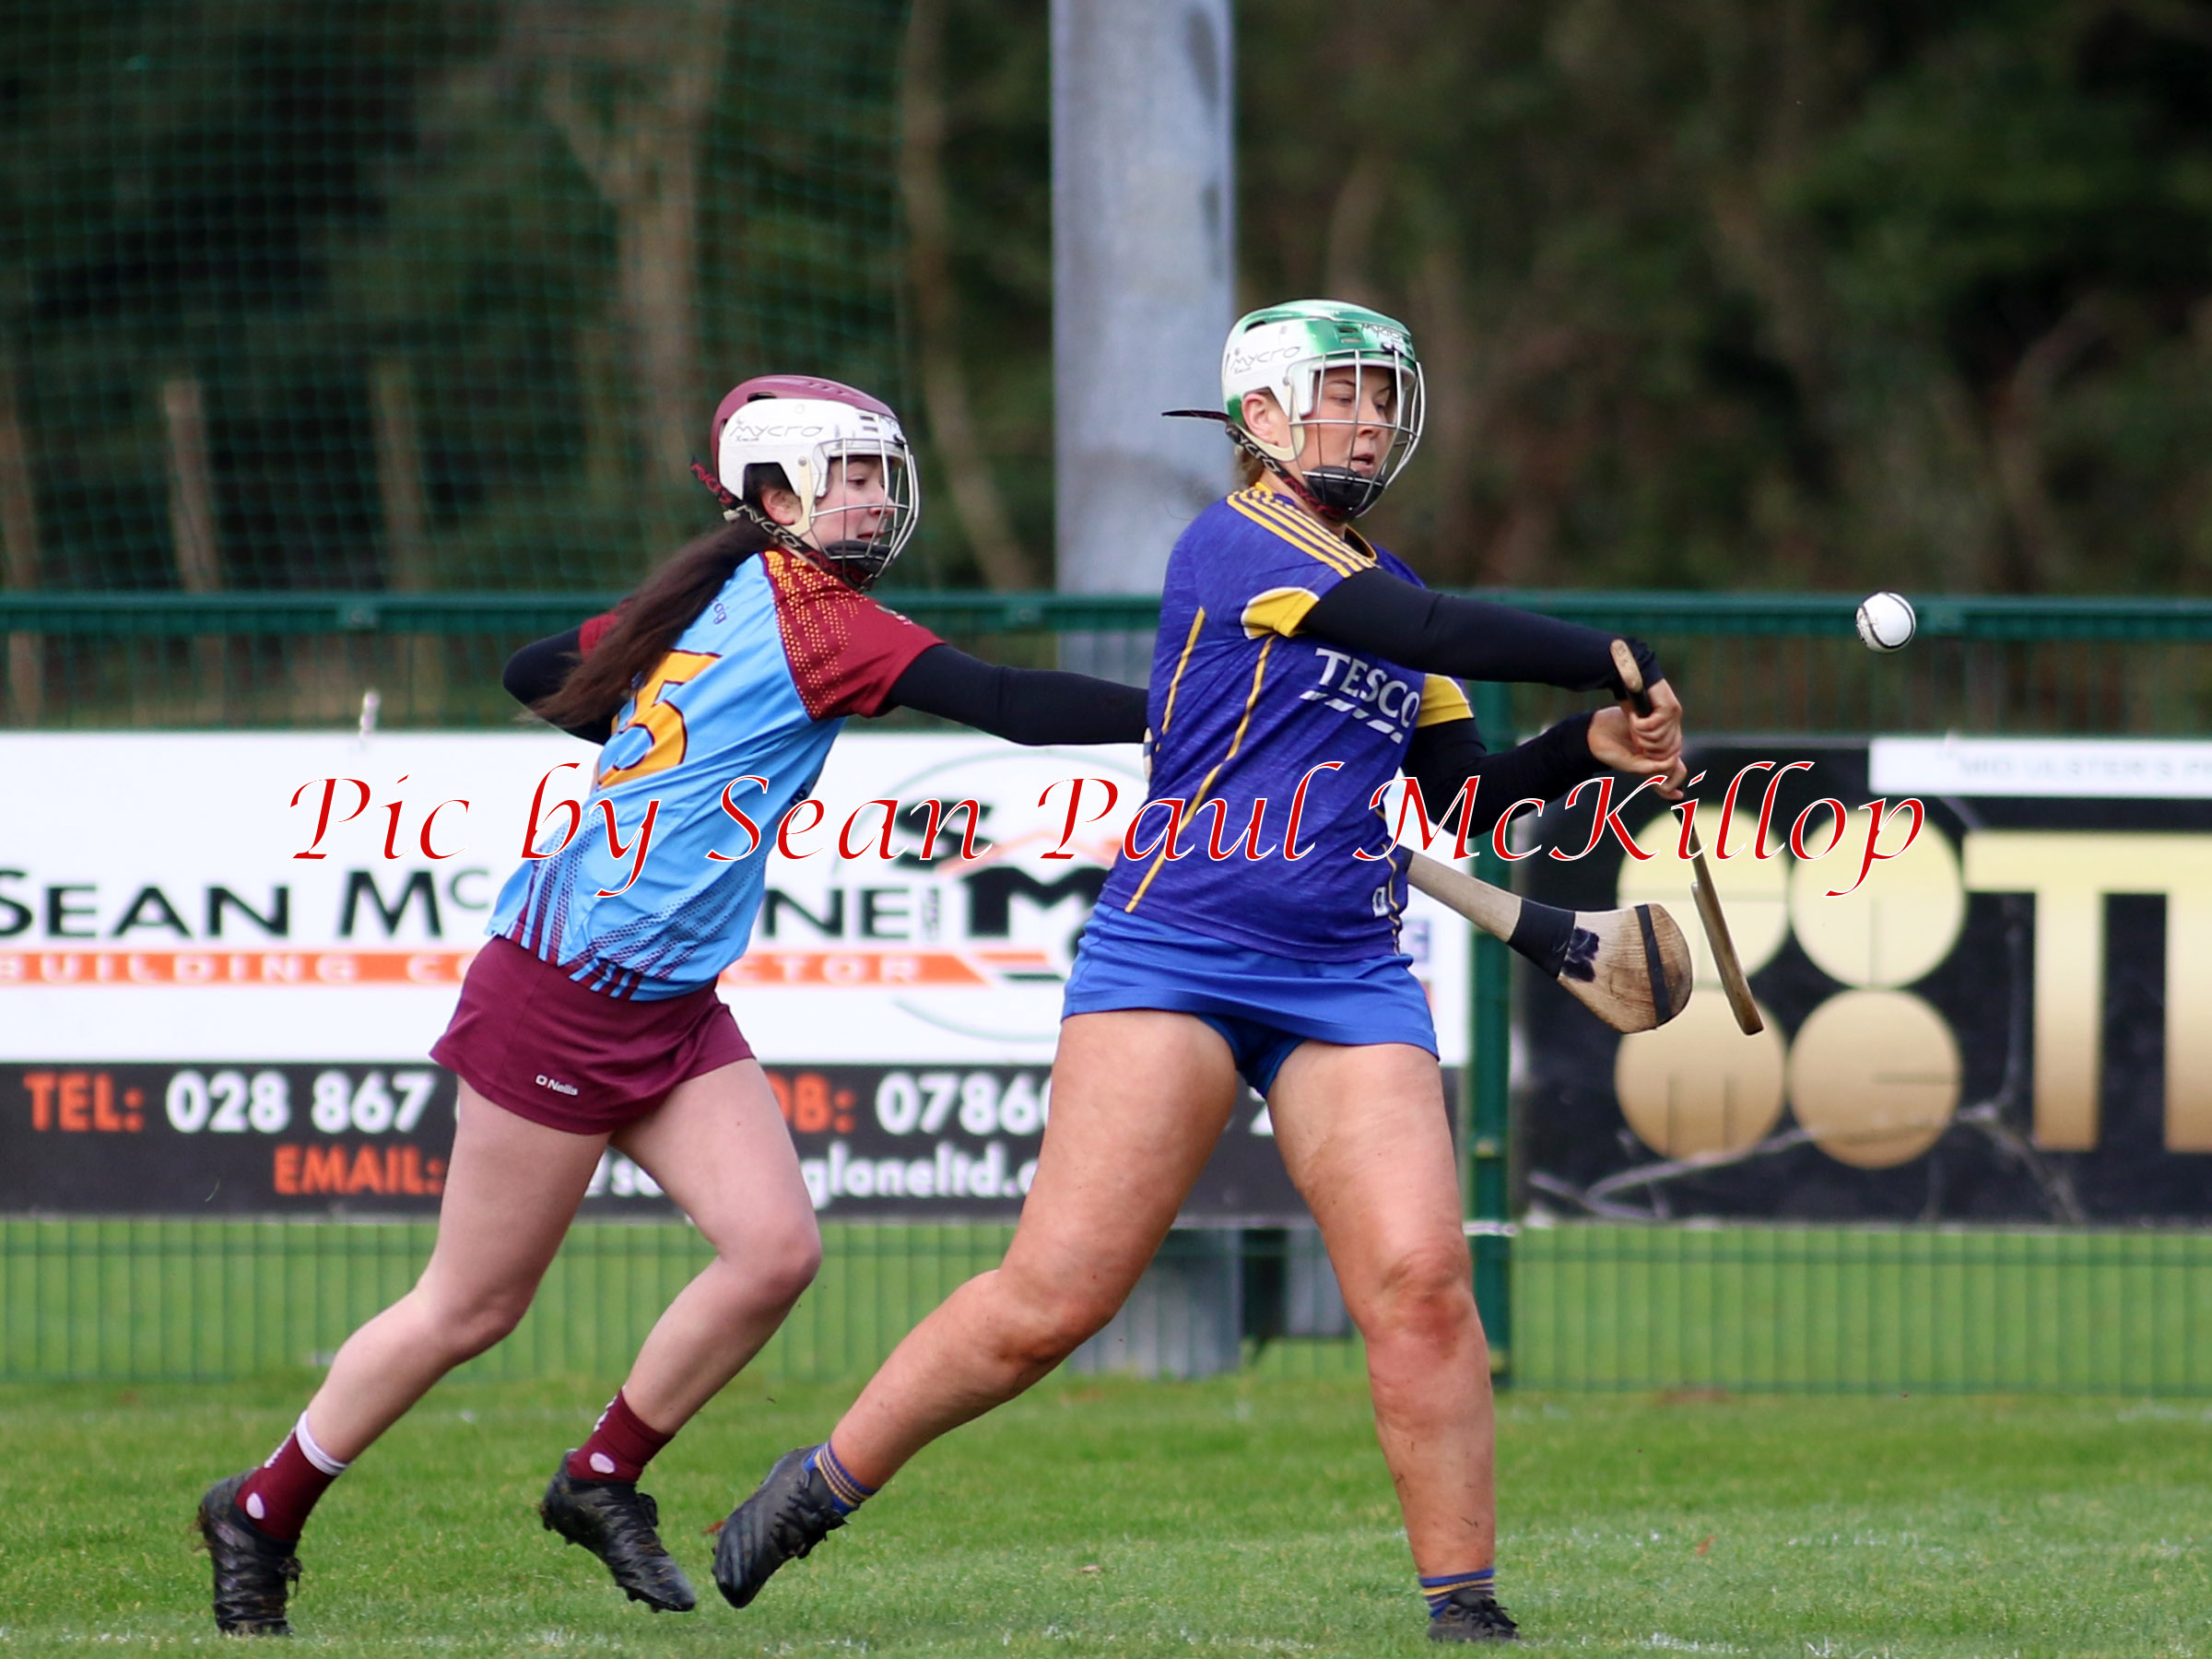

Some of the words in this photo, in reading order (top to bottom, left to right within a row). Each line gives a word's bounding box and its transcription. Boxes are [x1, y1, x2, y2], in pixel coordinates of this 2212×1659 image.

[1314, 647, 1420, 728] TESCO
[0, 867, 291, 939] SEAN
[23, 1072, 145, 1133] TEL:
[166, 1070, 290, 1135] 028
[311, 1070, 437, 1135] 867
[875, 1071, 1053, 1135] 0786
[274, 1146, 445, 1195] EMAIL:
